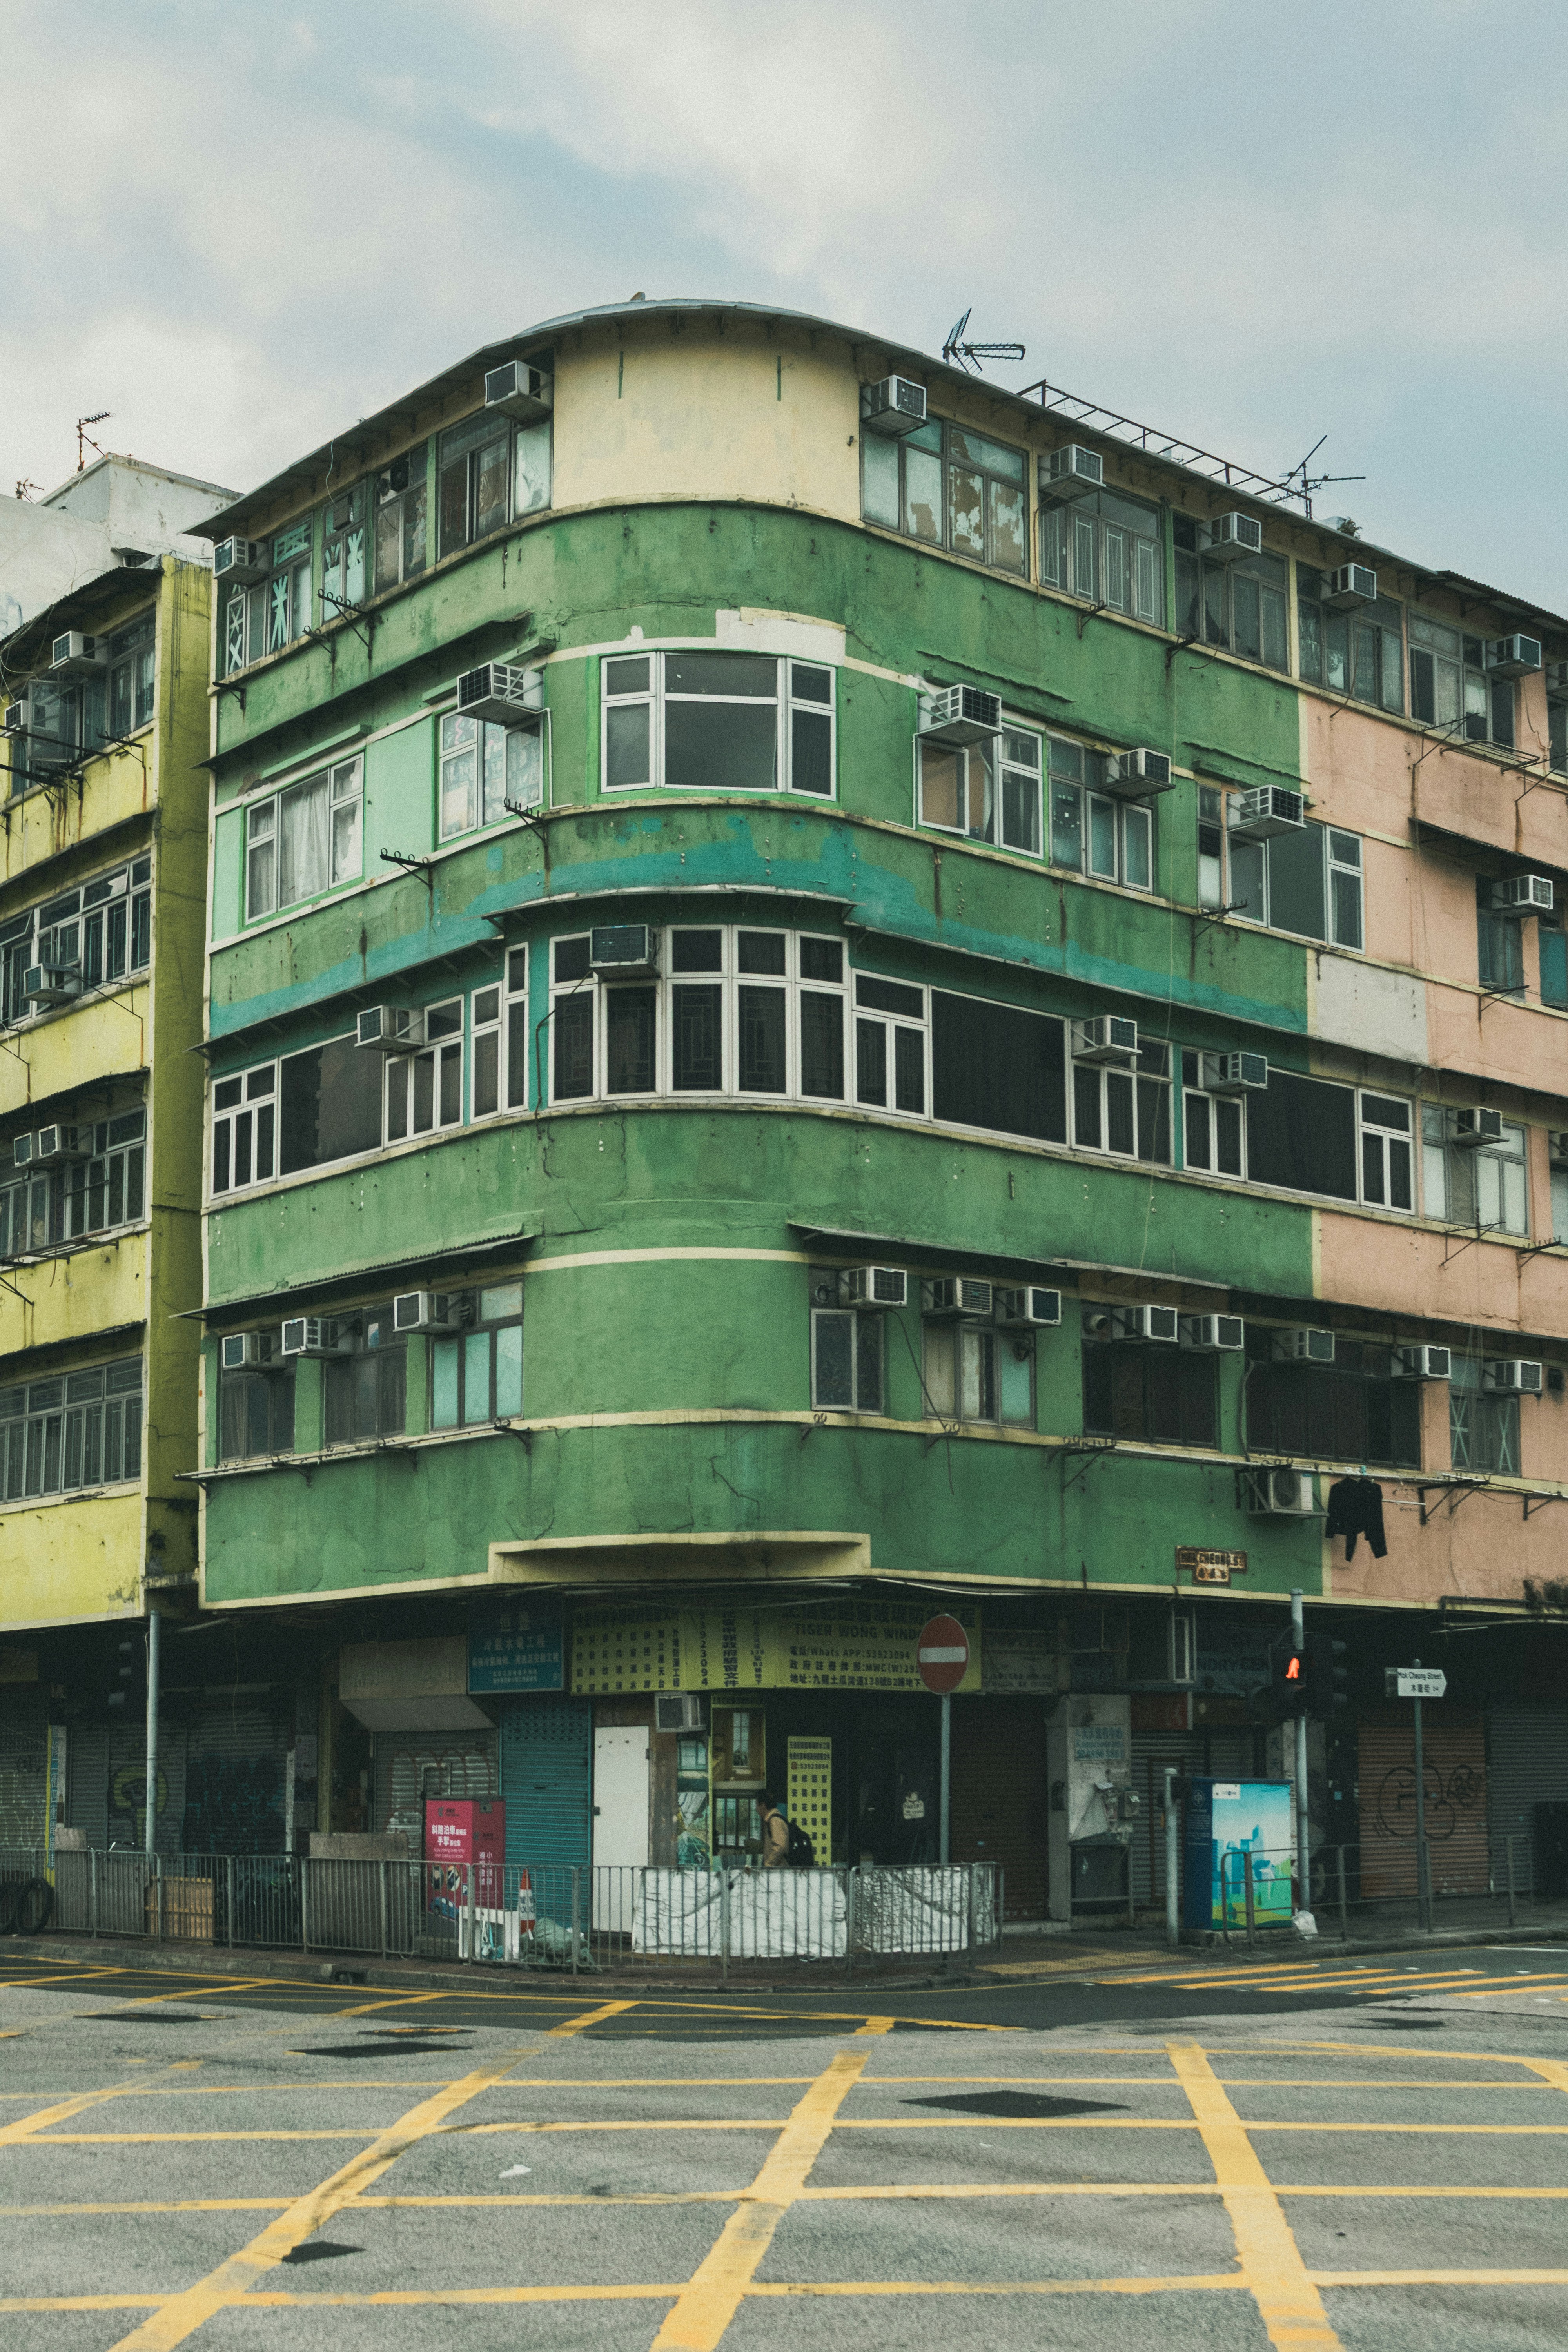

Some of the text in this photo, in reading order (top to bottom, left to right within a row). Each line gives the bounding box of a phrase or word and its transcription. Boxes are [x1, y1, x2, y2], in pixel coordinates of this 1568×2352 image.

[795, 1623, 832, 1635] TIGER
[838, 1625, 877, 1638] WONG
[1409, 1672, 1426, 1681] Cheong
